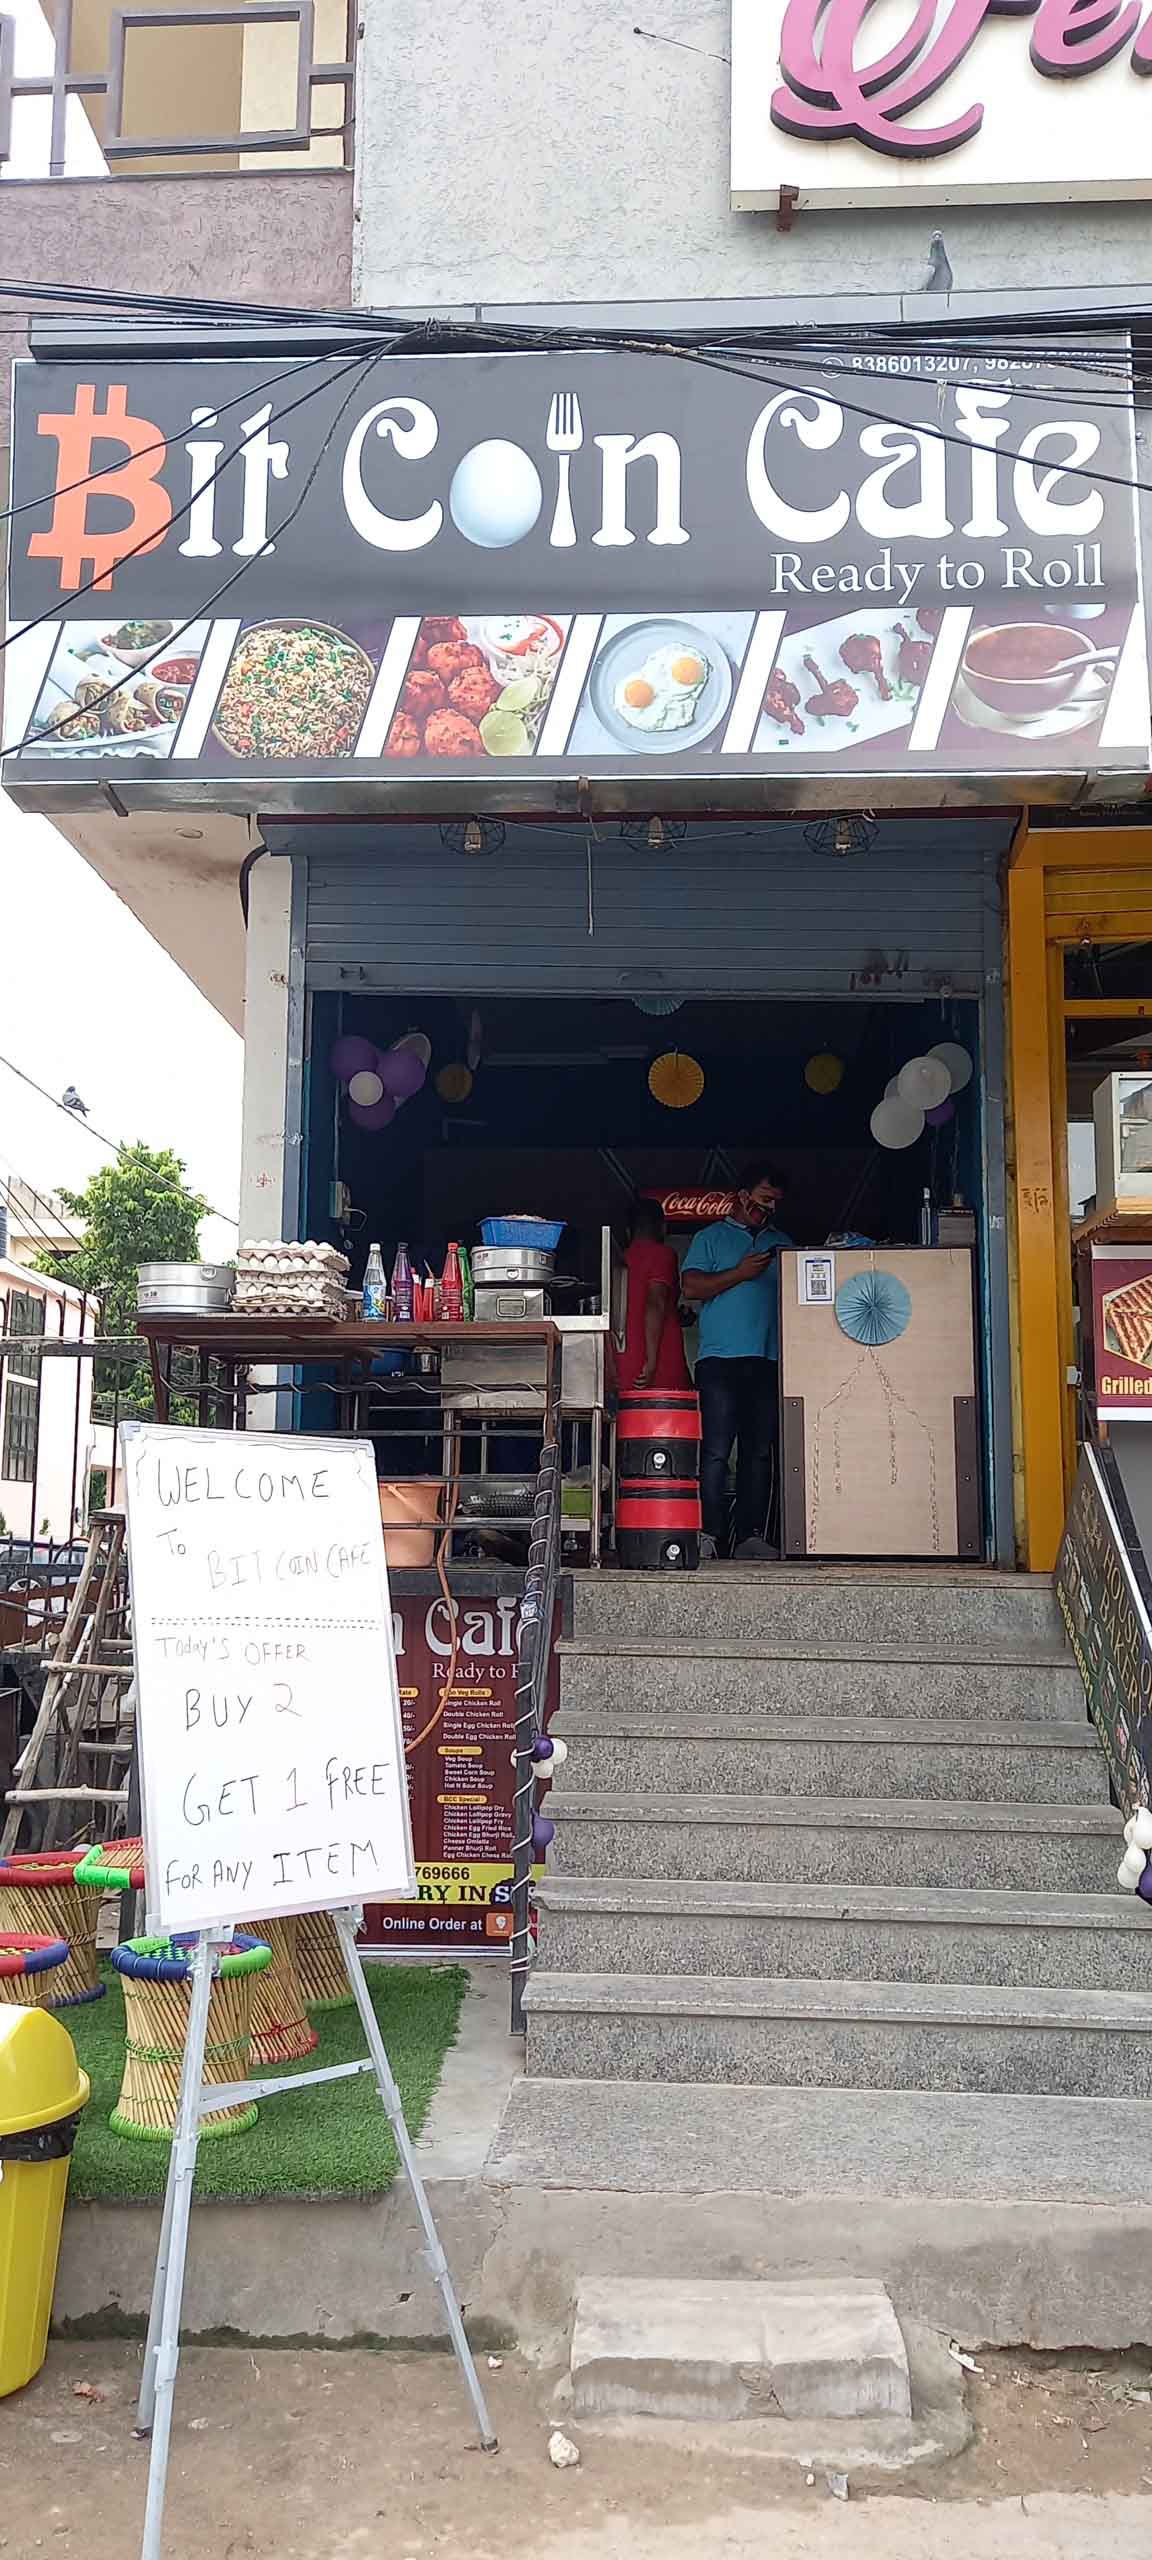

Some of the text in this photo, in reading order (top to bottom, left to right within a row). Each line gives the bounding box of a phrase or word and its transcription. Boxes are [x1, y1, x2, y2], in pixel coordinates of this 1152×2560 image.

[27, 384, 290, 591] Bit
[746, 378, 1105, 543] Cafe
[770, 543, 1104, 604] Ready to Roll
[158, 1458, 329, 1507] WELCOME
[156, 1528, 186, 1555] To
[425, 1597, 521, 1655] Caf
[245, 1641, 312, 1667] OFFER
[490, 1666, 506, 1679] to
[185, 1683, 302, 1731] BUY 2
[183, 1773, 259, 1825] GET
[286, 1768, 308, 1811] 1
[165, 1840, 378, 1896] FOR ANY ITEM
[458, 1885, 487, 1901] IN
[383, 1917, 483, 1931] Online Order at
